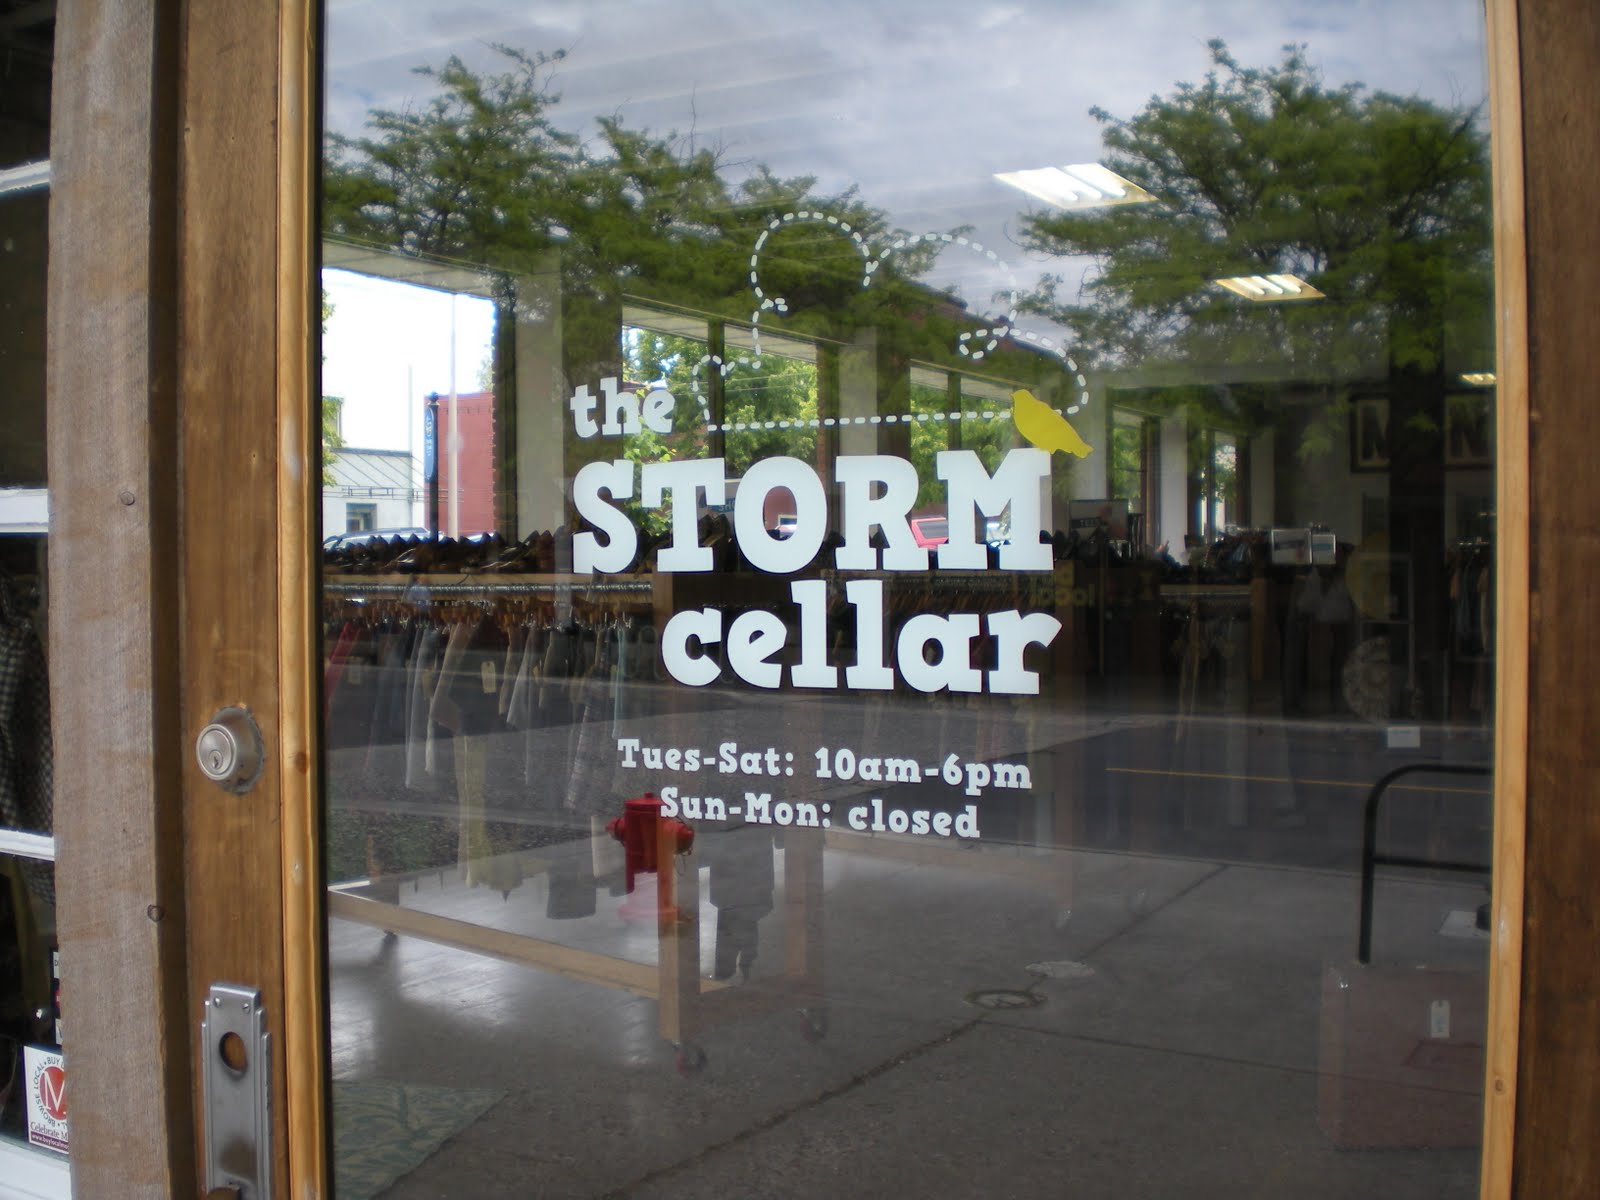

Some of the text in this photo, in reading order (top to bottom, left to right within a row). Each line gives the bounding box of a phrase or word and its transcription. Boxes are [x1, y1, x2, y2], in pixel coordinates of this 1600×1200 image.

[570, 377, 676, 438] the
[573, 447, 1054, 573] STORM
[661, 579, 1062, 695] cellar
[617, 738, 1032, 796] Tues-Sat: 10am-6pm
[660, 786, 980, 838] Sun-Mon: closed
[31, 1121, 59, 1138] Celebrate
